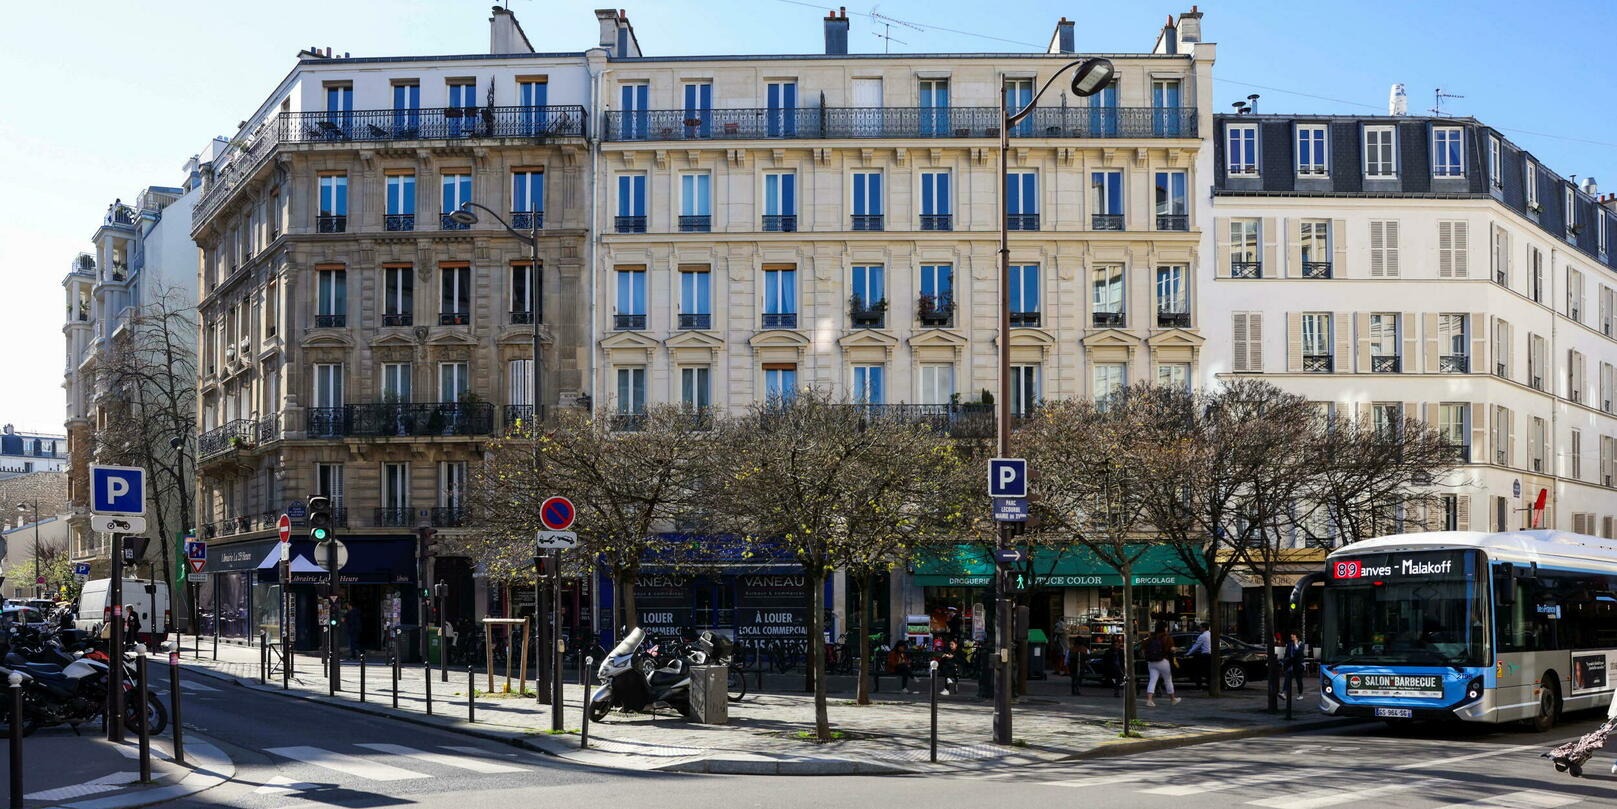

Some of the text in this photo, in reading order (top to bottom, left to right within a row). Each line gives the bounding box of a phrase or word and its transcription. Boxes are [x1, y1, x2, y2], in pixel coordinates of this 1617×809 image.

[1000, 466, 1016, 490] P
[107, 476, 129, 505] P
[1337, 563, 1357, 577] 89
[1361, 566, 1391, 576] anves
[1402, 560, 1452, 574] Malakoff
[634, 576, 684, 587] ANEAU
[744, 576, 805, 587] VANEAU
[1066, 576, 1102, 584] COLOR
[644, 612, 674, 624] LOUER
[756, 610, 792, 624] À LOUER
[1365, 676, 1436, 687] SALON BARBECUE
